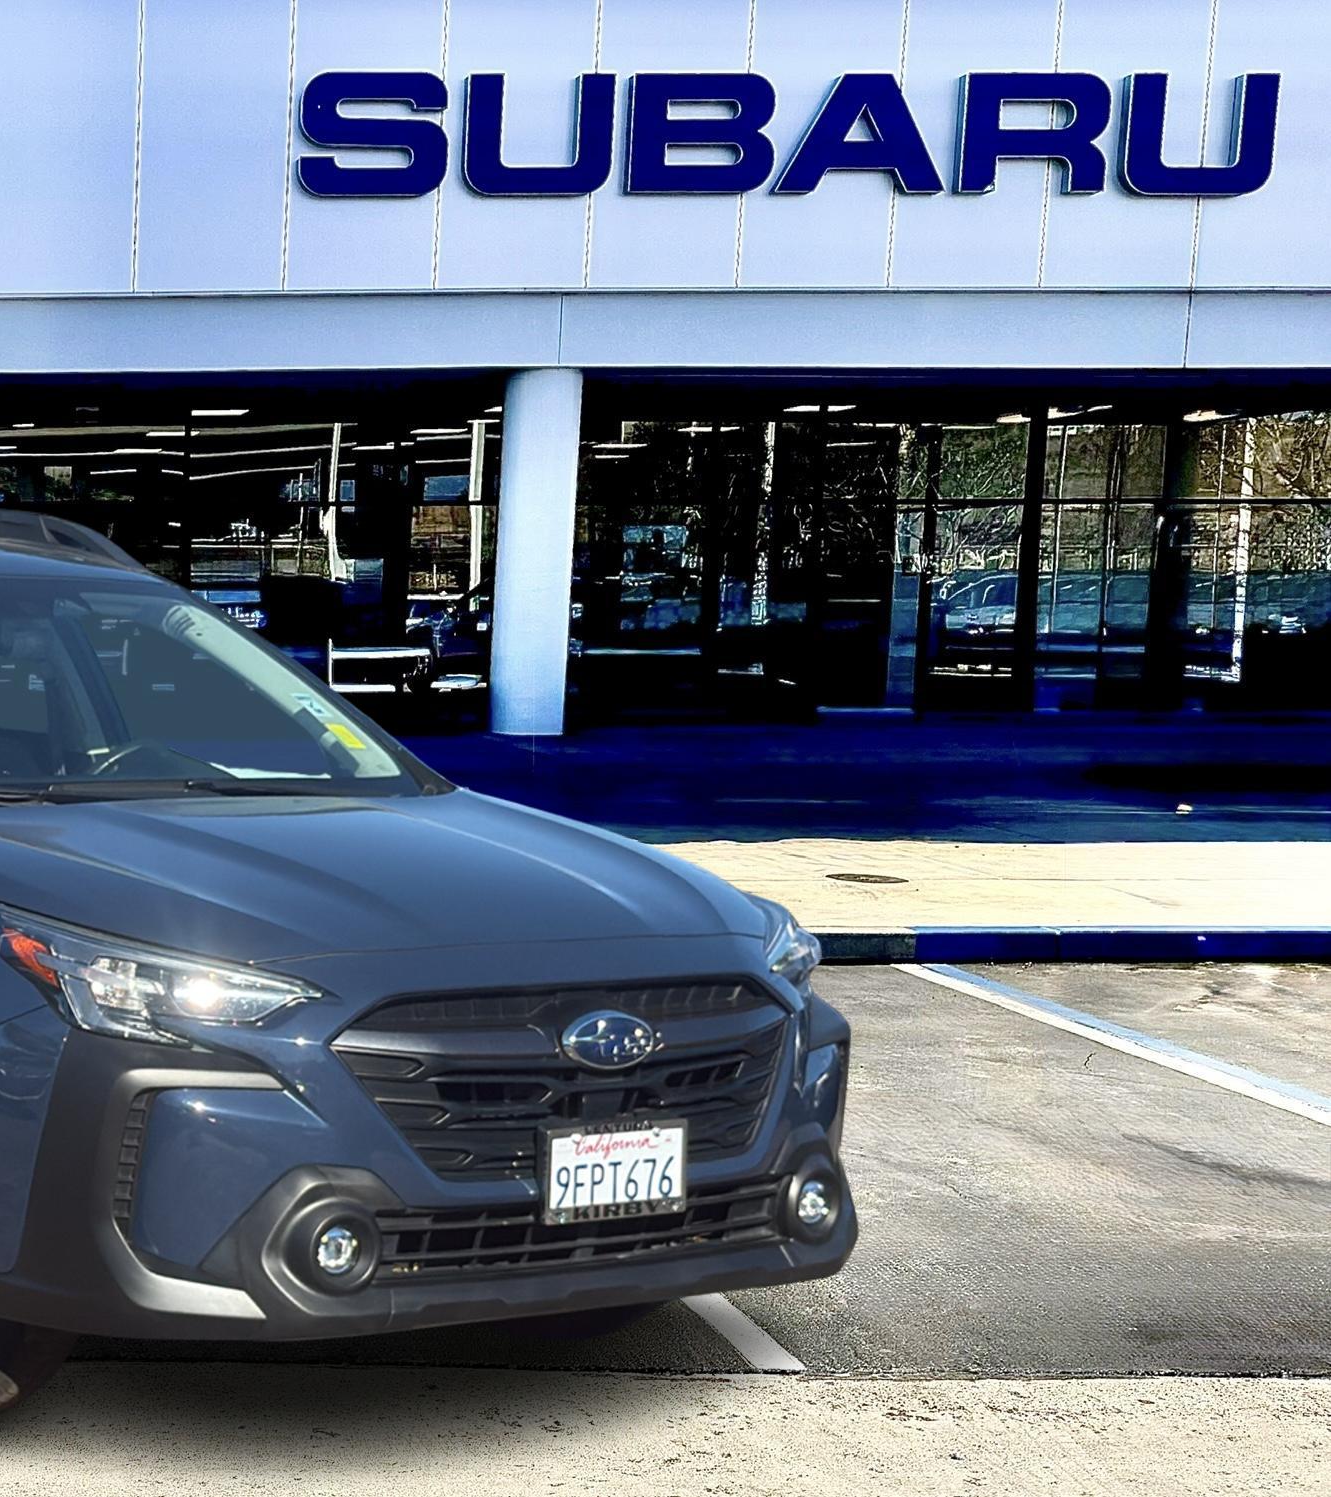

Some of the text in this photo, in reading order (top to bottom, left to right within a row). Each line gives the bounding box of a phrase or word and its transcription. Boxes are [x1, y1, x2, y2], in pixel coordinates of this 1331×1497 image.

[297, 72, 1282, 197] SUBARU
[572, 1134, 659, 1159] California
[556, 1155, 674, 1208] 9FPT676
[573, 1200, 659, 1220] KIRBY
